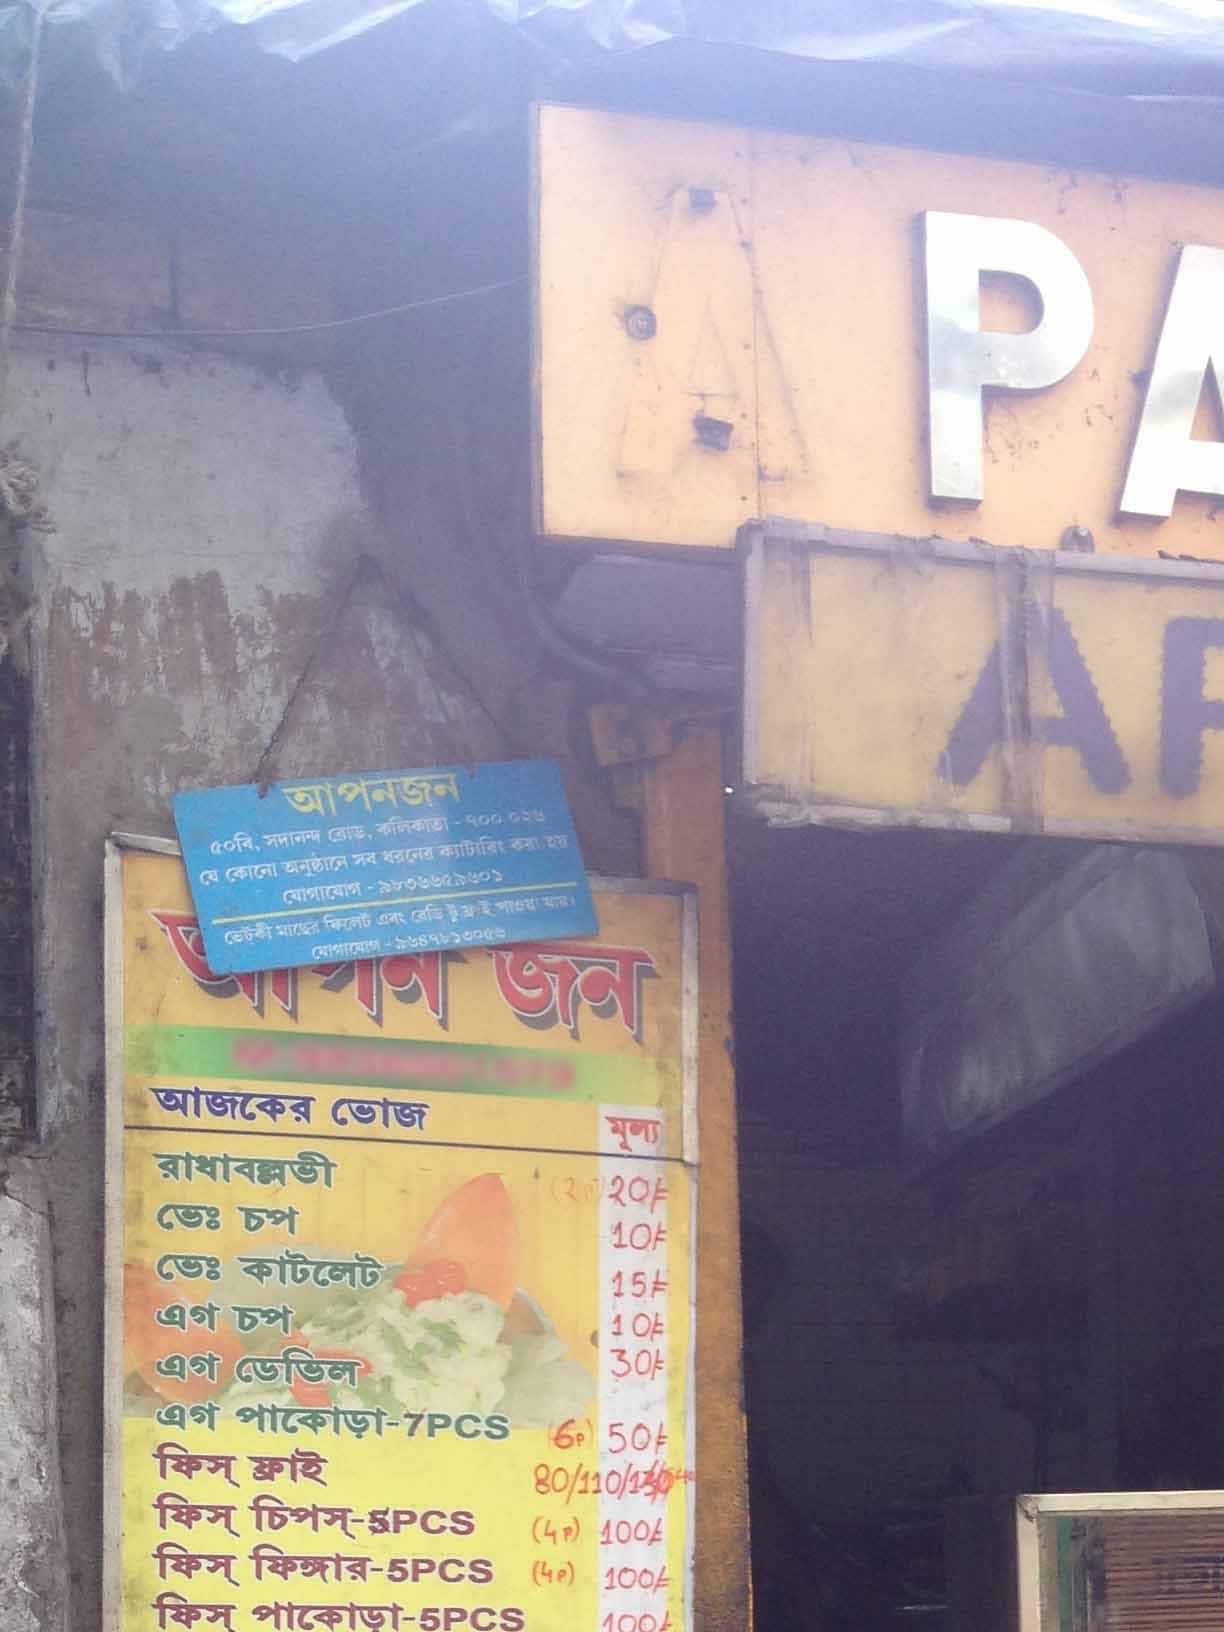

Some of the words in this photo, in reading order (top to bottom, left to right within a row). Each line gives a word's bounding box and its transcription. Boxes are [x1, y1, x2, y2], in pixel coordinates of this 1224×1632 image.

[282, 773, 460, 817] আপনজন
[264, 830, 320, 848] সদানন্দ
[200, 869, 218, 886] যে
[226, 863, 277, 883] কোনো
[281, 852, 348, 878] অনুষ্ঠানে
[352, 851, 376, 866] সব
[384, 847, 434, 865] ধরনের
[283, 881, 360, 904] যোগাযোগ
[277, 921, 320, 938] মাছের
[378, 911, 407, 927] এবং
[312, 939, 380, 959] যোগাযোগ
[487, 941, 657, 1035] জন
[149, 1086, 316, 1123] আজকের
[332, 1097, 430, 1131] ভোজ
[153, 1151, 338, 1188] রাধাবল্লভী
[157, 1204, 221, 1230] ভেঃ
[237, 1206, 299, 1235] চপ
[157, 1254, 221, 1280] ভেঃ
[237, 1250, 384, 1288] কাটলেট
[156, 1302, 221, 1332] এগ
[232, 1304, 293, 1335] চপ
[156, 1352, 221, 1382] এগ
[236, 1346, 363, 1386] ডেভিল
[156, 1402, 221, 1431] এগ
[152, 1441, 240, 1488] ফিস্
[247, 1448, 328, 1487] ফ্রাই
[152, 1492, 240, 1537] ফিস্
[152, 1541, 240, 1587] ফিস্
